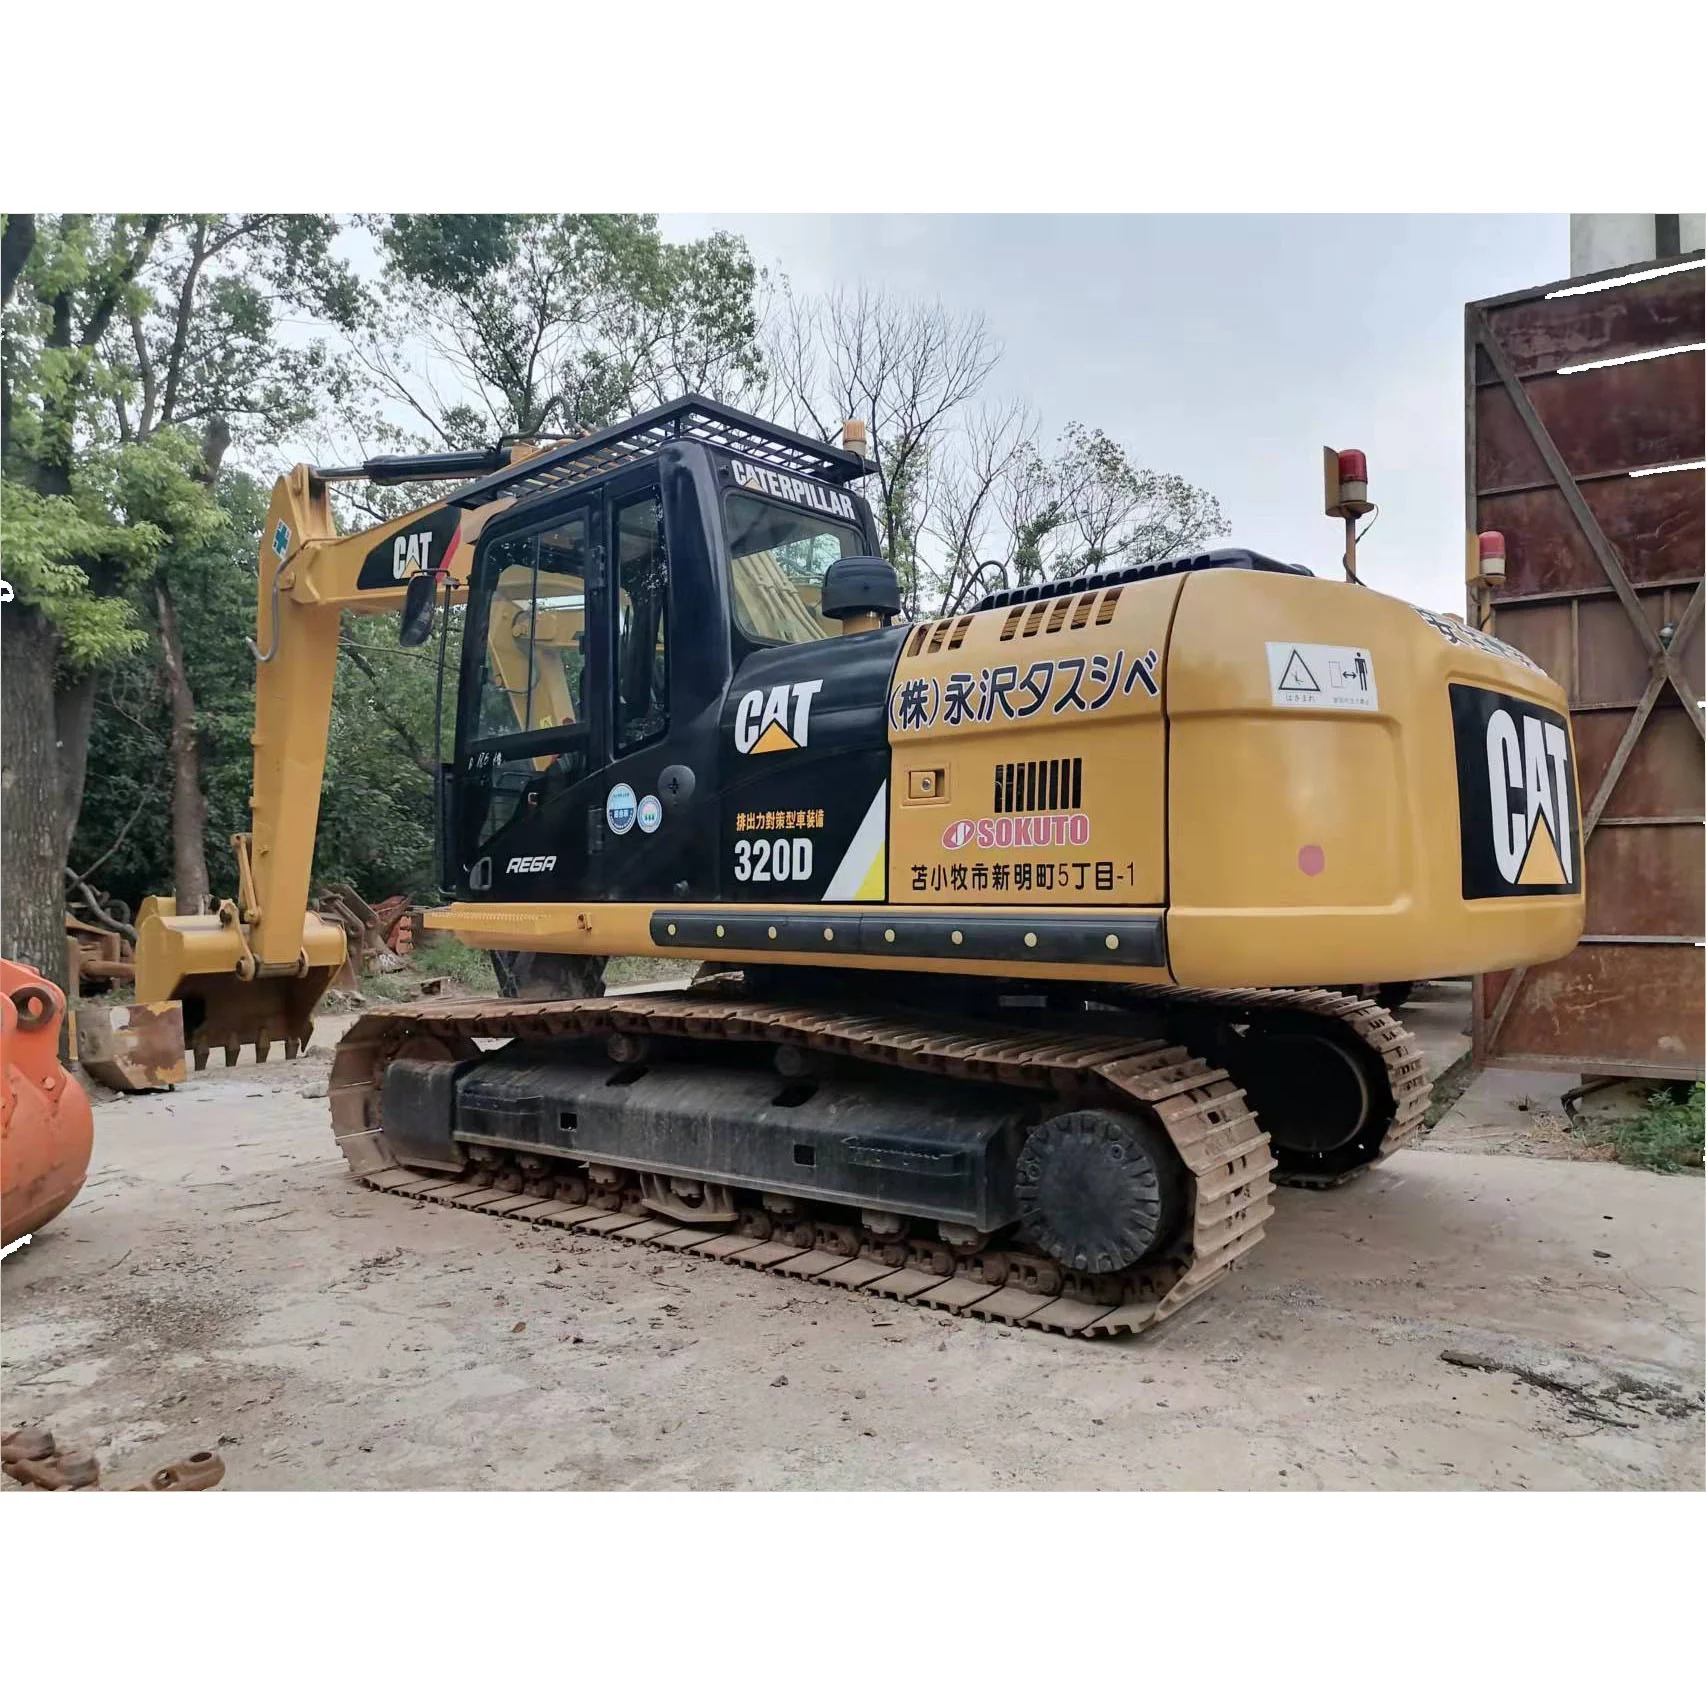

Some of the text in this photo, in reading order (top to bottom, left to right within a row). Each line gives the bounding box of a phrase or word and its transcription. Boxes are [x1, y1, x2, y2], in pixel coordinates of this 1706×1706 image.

[731, 459, 857, 520] CATERPILLAR
[393, 531, 433, 579] CAT
[735, 680, 824, 755] CAT
[1486, 709, 1573, 884] CAT
[976, 814, 1090, 849] SOKUTO
[505, 855, 557, 874] REGA
[734, 838, 813, 881] 320D
